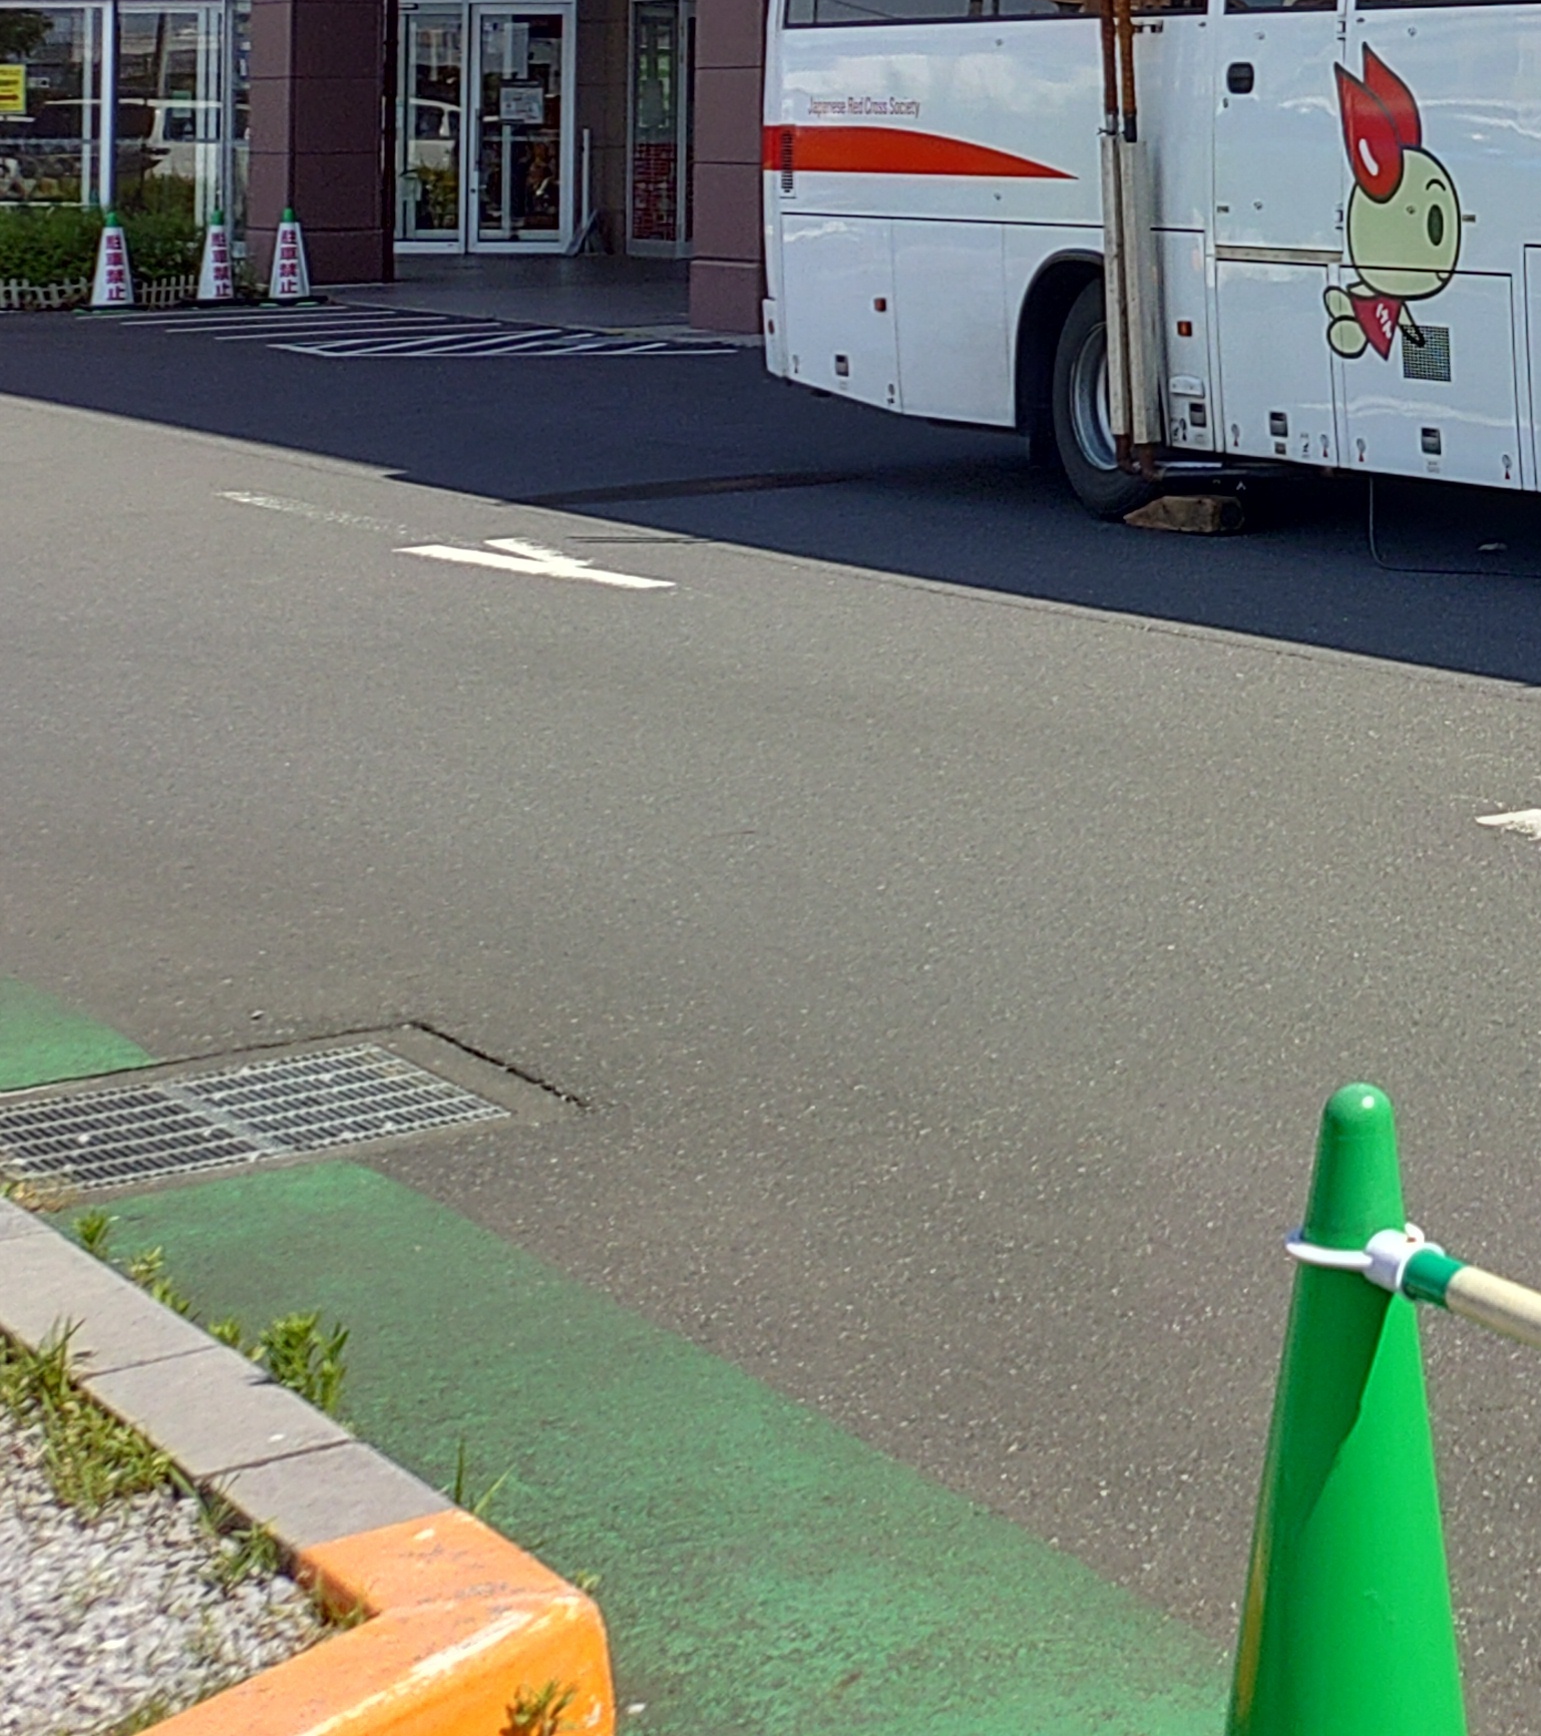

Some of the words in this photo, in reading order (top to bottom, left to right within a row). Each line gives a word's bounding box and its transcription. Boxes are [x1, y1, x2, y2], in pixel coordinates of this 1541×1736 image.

[807, 95, 846, 118] Japanese
[847, 95, 864, 115] Red
[864, 96, 888, 115] Cross
[888, 96, 921, 119] Society
[280, 230, 298, 294] 駐車禁止
